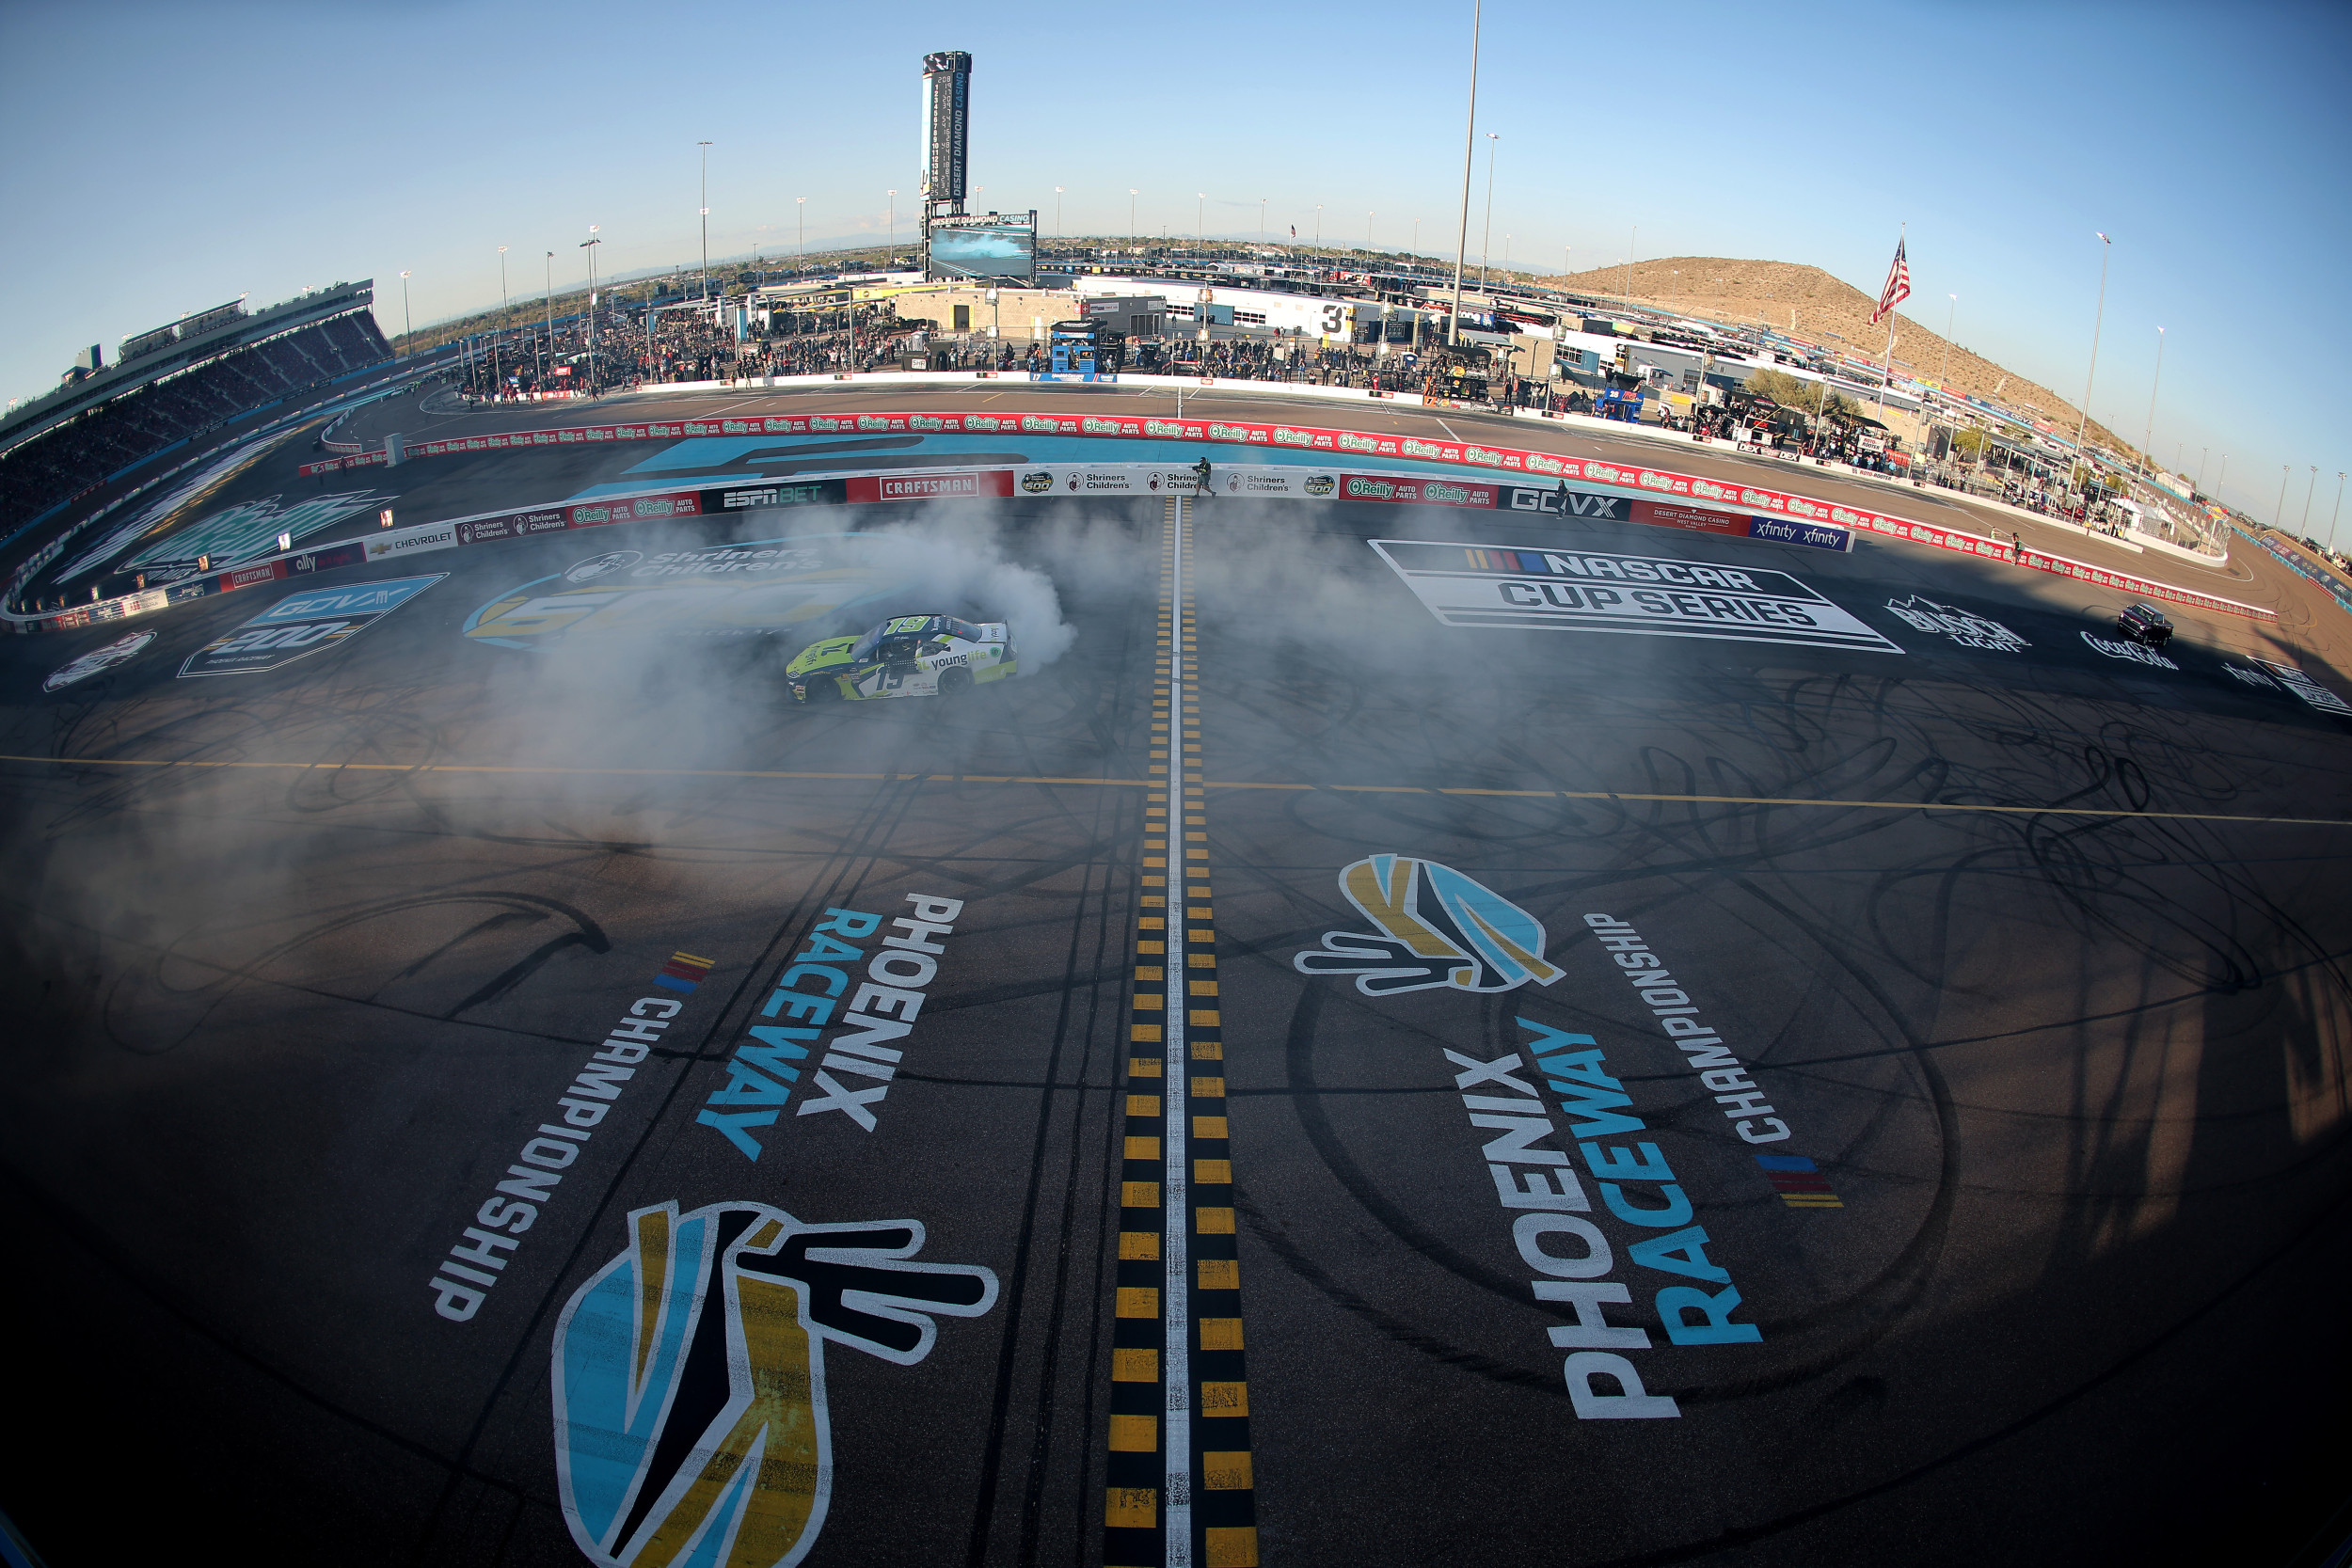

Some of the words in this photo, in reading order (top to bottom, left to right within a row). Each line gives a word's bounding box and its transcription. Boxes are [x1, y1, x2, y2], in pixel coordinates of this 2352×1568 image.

[954, 110, 962, 157] DIAMOND
[930, 217, 960, 226] DESERT
[961, 215, 997, 224] DIAMOND
[1322, 305, 1342, 333] 3
[1022, 416, 1059, 433] O'Reilly
[1082, 418, 1121, 435] O'Reilly
[1144, 420, 1184, 438] O'Reilly
[1208, 423, 1248, 442] O'Reilly
[1273, 428, 1314, 446] O'Reilly
[1338, 434, 1379, 452] O'Reilly
[1402, 440, 1442, 459] O'Reilly
[1465, 447, 1504, 466] O'Reilly
[1739, 444, 1760, 453] DEX
[1779, 451, 1799, 461] DEX
[886, 479, 971, 495] CRAFTSMAN
[1024, 482, 1050, 491] 500
[1248, 483, 1289, 492] Children's
[1306, 484, 1331, 495] 500
[1347, 478, 1394, 499] O'Reilly
[1424, 483, 1470, 504] O'Reilly
[724, 489, 777, 508] ESPN
[779, 485, 822, 502] BET
[1511, 488, 1618, 518] GOVX
[572, 506, 611, 525] O'Reilly
[634, 499, 675, 516] O'Reilly
[675, 504, 695, 514] PARTS
[474, 521, 503, 531] Shriners
[529, 512, 561, 523] Shriners
[531, 521, 565, 531] Children's
[476, 529, 509, 539] Children's
[1757, 521, 1796, 540] xfinity
[1803, 529, 1840, 547] xfinity
[395, 532, 452, 549] CHEVROLET
[296, 553, 316, 572] ally
[647, 548, 818, 563] Shriners
[235, 567, 271, 583] CRAFTSMAN
[630, 559, 822, 578] Children's
[1544, 553, 1764, 591] NASCAR
[267, 587, 410, 617] GOVX
[1498, 583, 1622, 610] CUP
[1630, 591, 1818, 626] SERIES
[883, 615, 931, 636] 19
[1883, 606, 2032, 646] BUSCH
[209, 622, 351, 655] 200
[1947, 635, 2023, 653] LIGHT
[876, 666, 905, 690] 19
[796, 893, 963, 1132] PHOENIX
[694, 907, 883, 1162] RACEWAY
[1582, 912, 1791, 1145] CHAMPIONSHIP
[429, 997, 683, 1323] CHAMPIONSHIP
[1515, 1016, 1763, 1345] RACEWAY
[1443, 1048, 1682, 1420] PHOENIX
